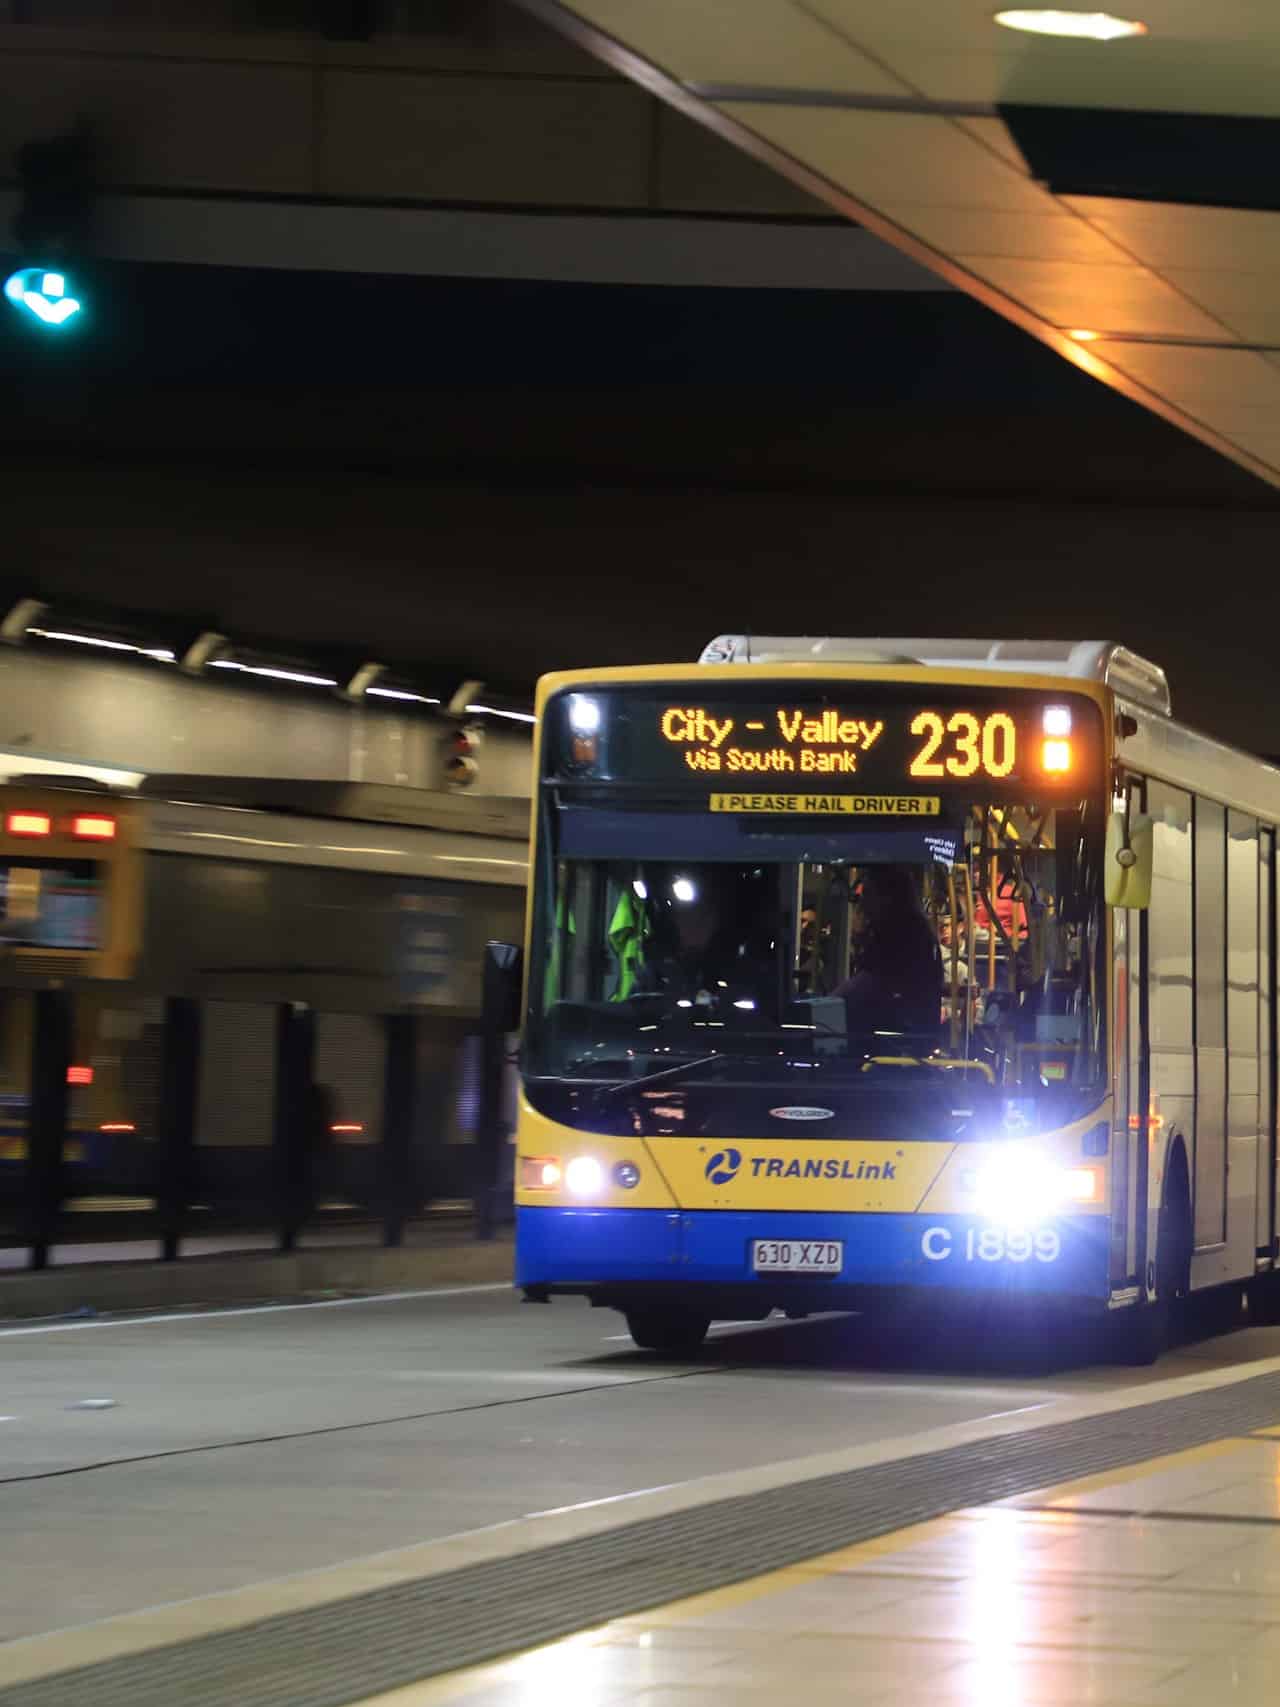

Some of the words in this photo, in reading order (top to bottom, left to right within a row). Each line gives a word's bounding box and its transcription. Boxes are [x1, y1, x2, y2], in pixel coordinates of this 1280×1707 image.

[661, 708, 734, 748] City
[776, 710, 884, 750] Valley
[910, 711, 1016, 777] 230
[685, 749, 721, 771] via
[726, 748, 795, 772] South
[801, 750, 857, 773] Bank
[730, 796, 796, 810] PLEASE
[804, 798, 844, 811] HAIL
[853, 799, 920, 813] DRIVER
[751, 1158, 896, 1180] TRANSLink
[921, 1226, 953, 1260] C
[965, 1228, 1061, 1263] 1899
